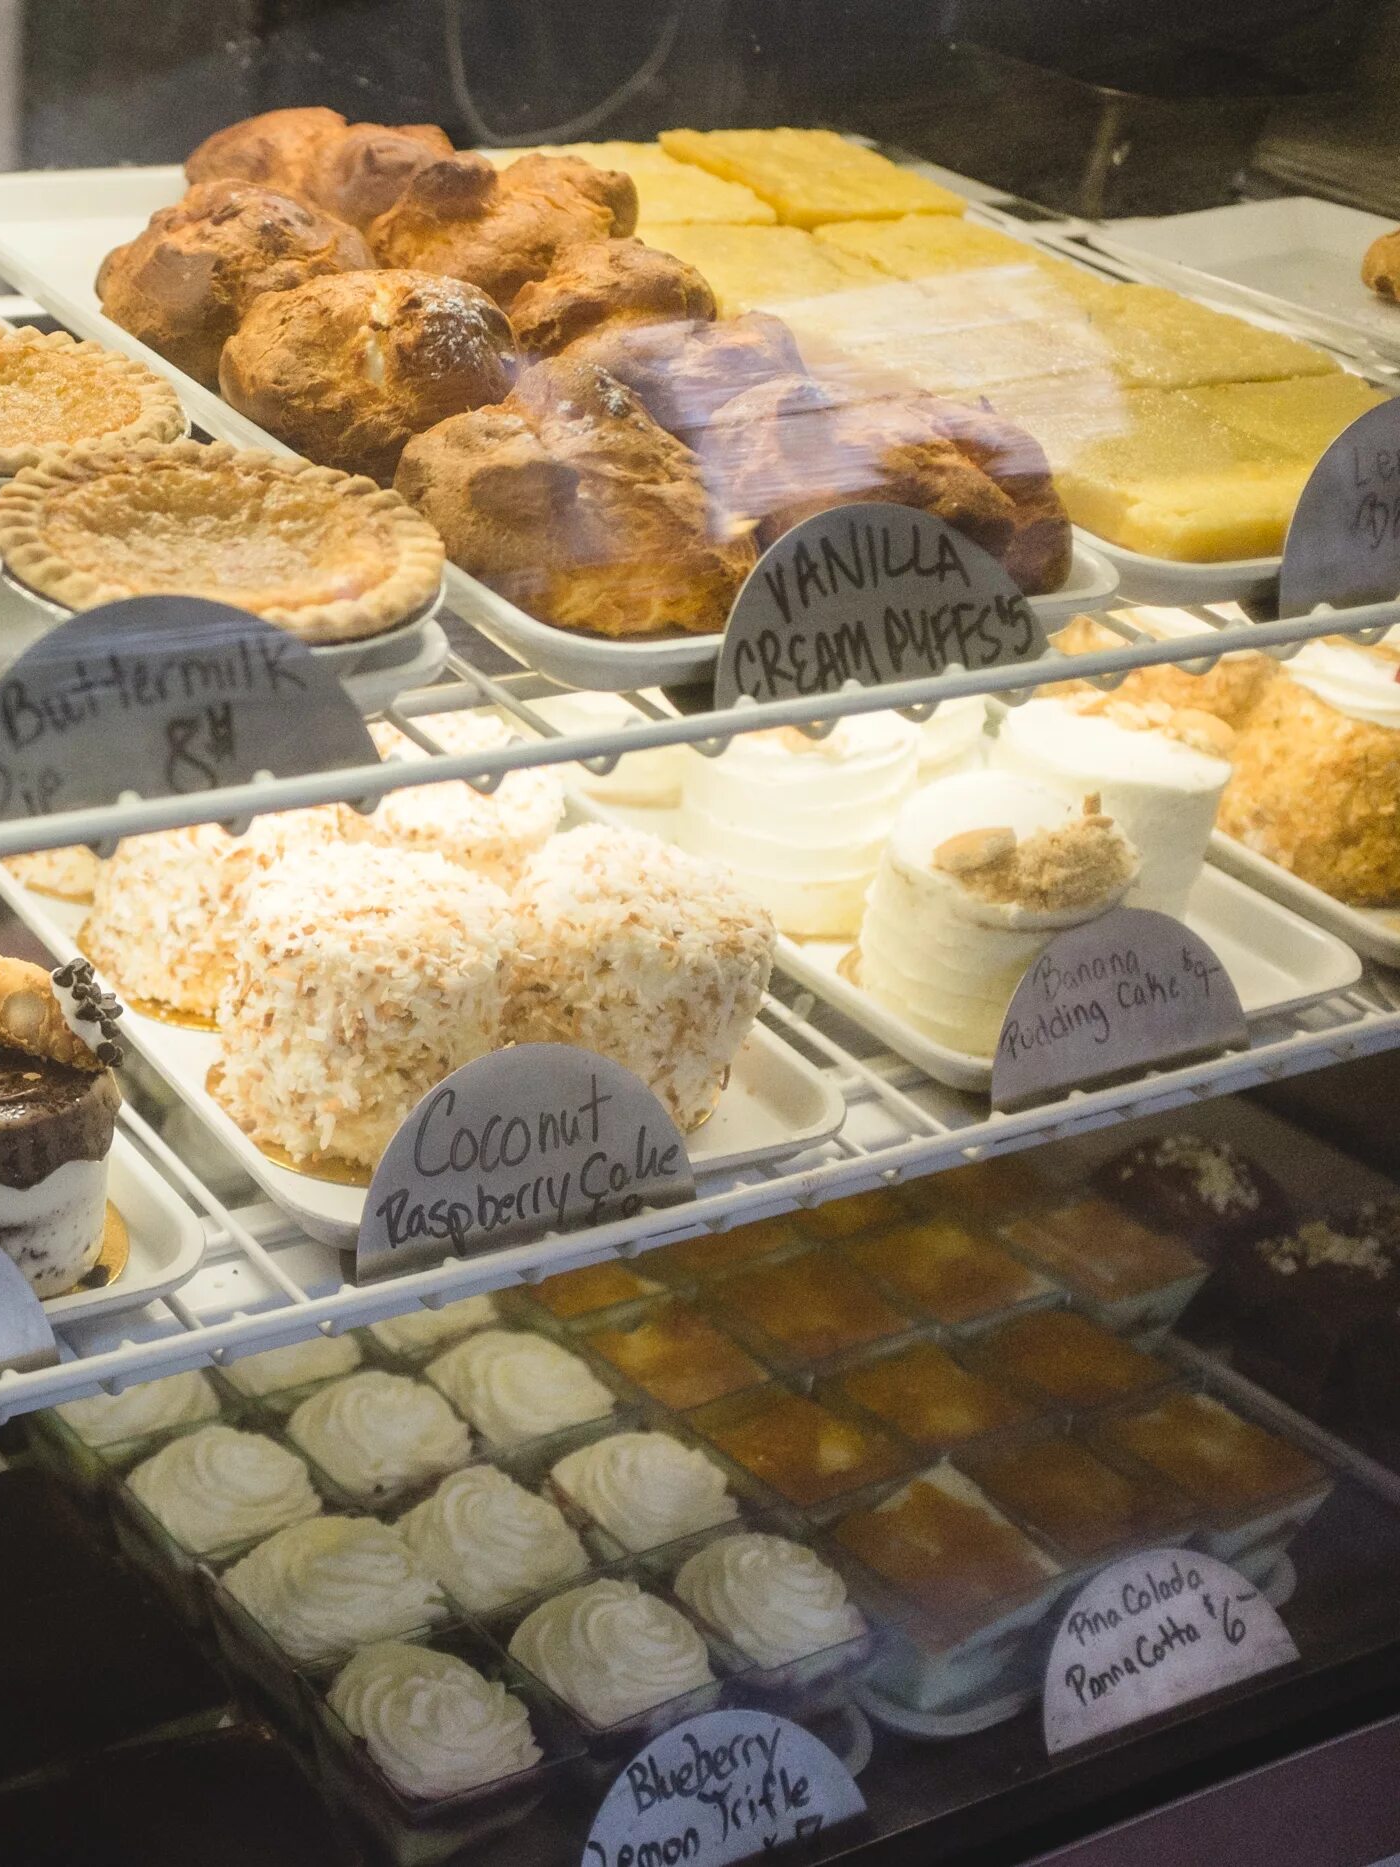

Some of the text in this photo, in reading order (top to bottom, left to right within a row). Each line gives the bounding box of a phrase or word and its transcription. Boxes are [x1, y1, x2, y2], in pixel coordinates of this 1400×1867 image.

[764, 522, 971, 625] VANILLA
[0, 637, 307, 753] Buttermilk
[734, 619, 882, 699] CREAM
[1000, 1000, 1111, 1060] Pudding
[1116, 971, 1180, 1009] Cake
[1032, 950, 1141, 1001] Banana
[413, 1073, 613, 1178] Coconut
[375, 1125, 679, 1258] Raspberry Cake
[1064, 1657, 1141, 1707] Panna
[1135, 1615, 1201, 1669] Cotta
[626, 1726, 781, 1816] Blueberry
[697, 1767, 811, 1842] Trifle
